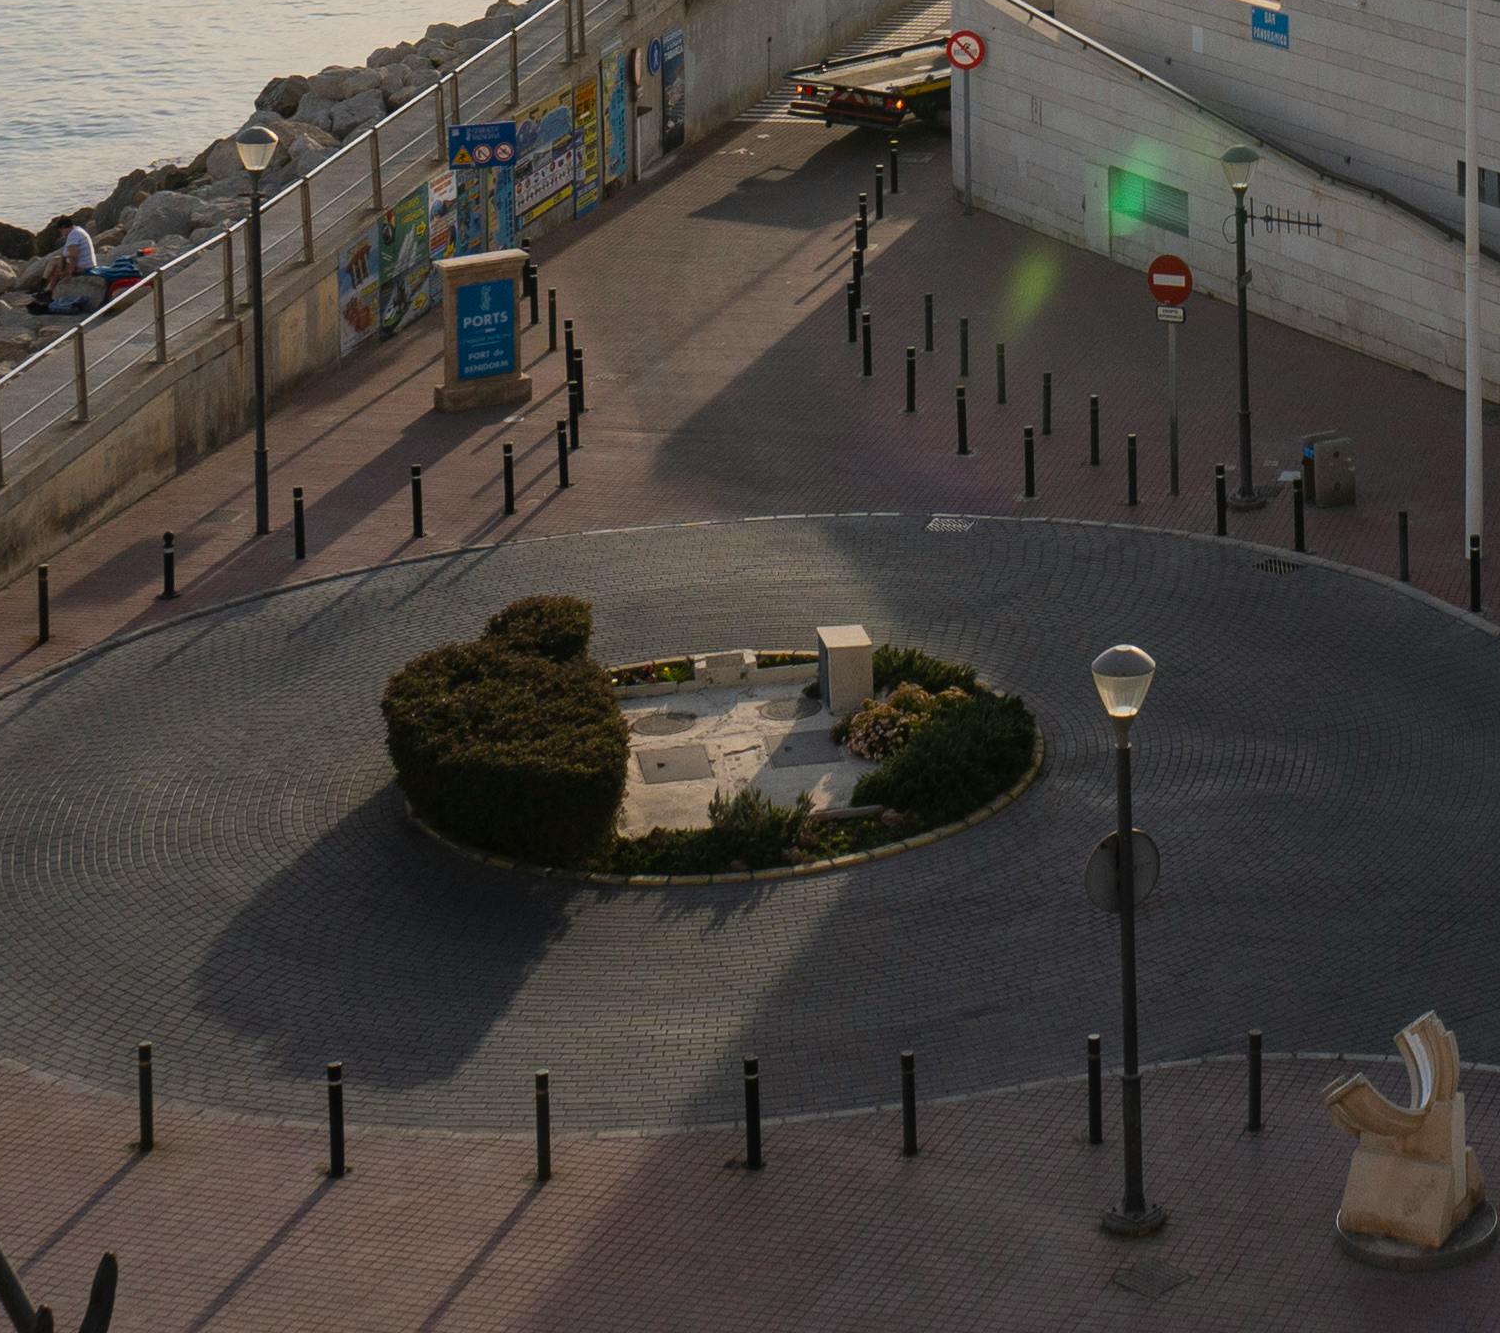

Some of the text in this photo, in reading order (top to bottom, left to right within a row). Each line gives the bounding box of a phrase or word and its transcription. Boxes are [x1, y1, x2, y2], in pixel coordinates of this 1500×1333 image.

[463, 311, 508, 329] PORTS
[467, 350, 490, 361] PORT
[464, 359, 509, 374] BENIDORM
